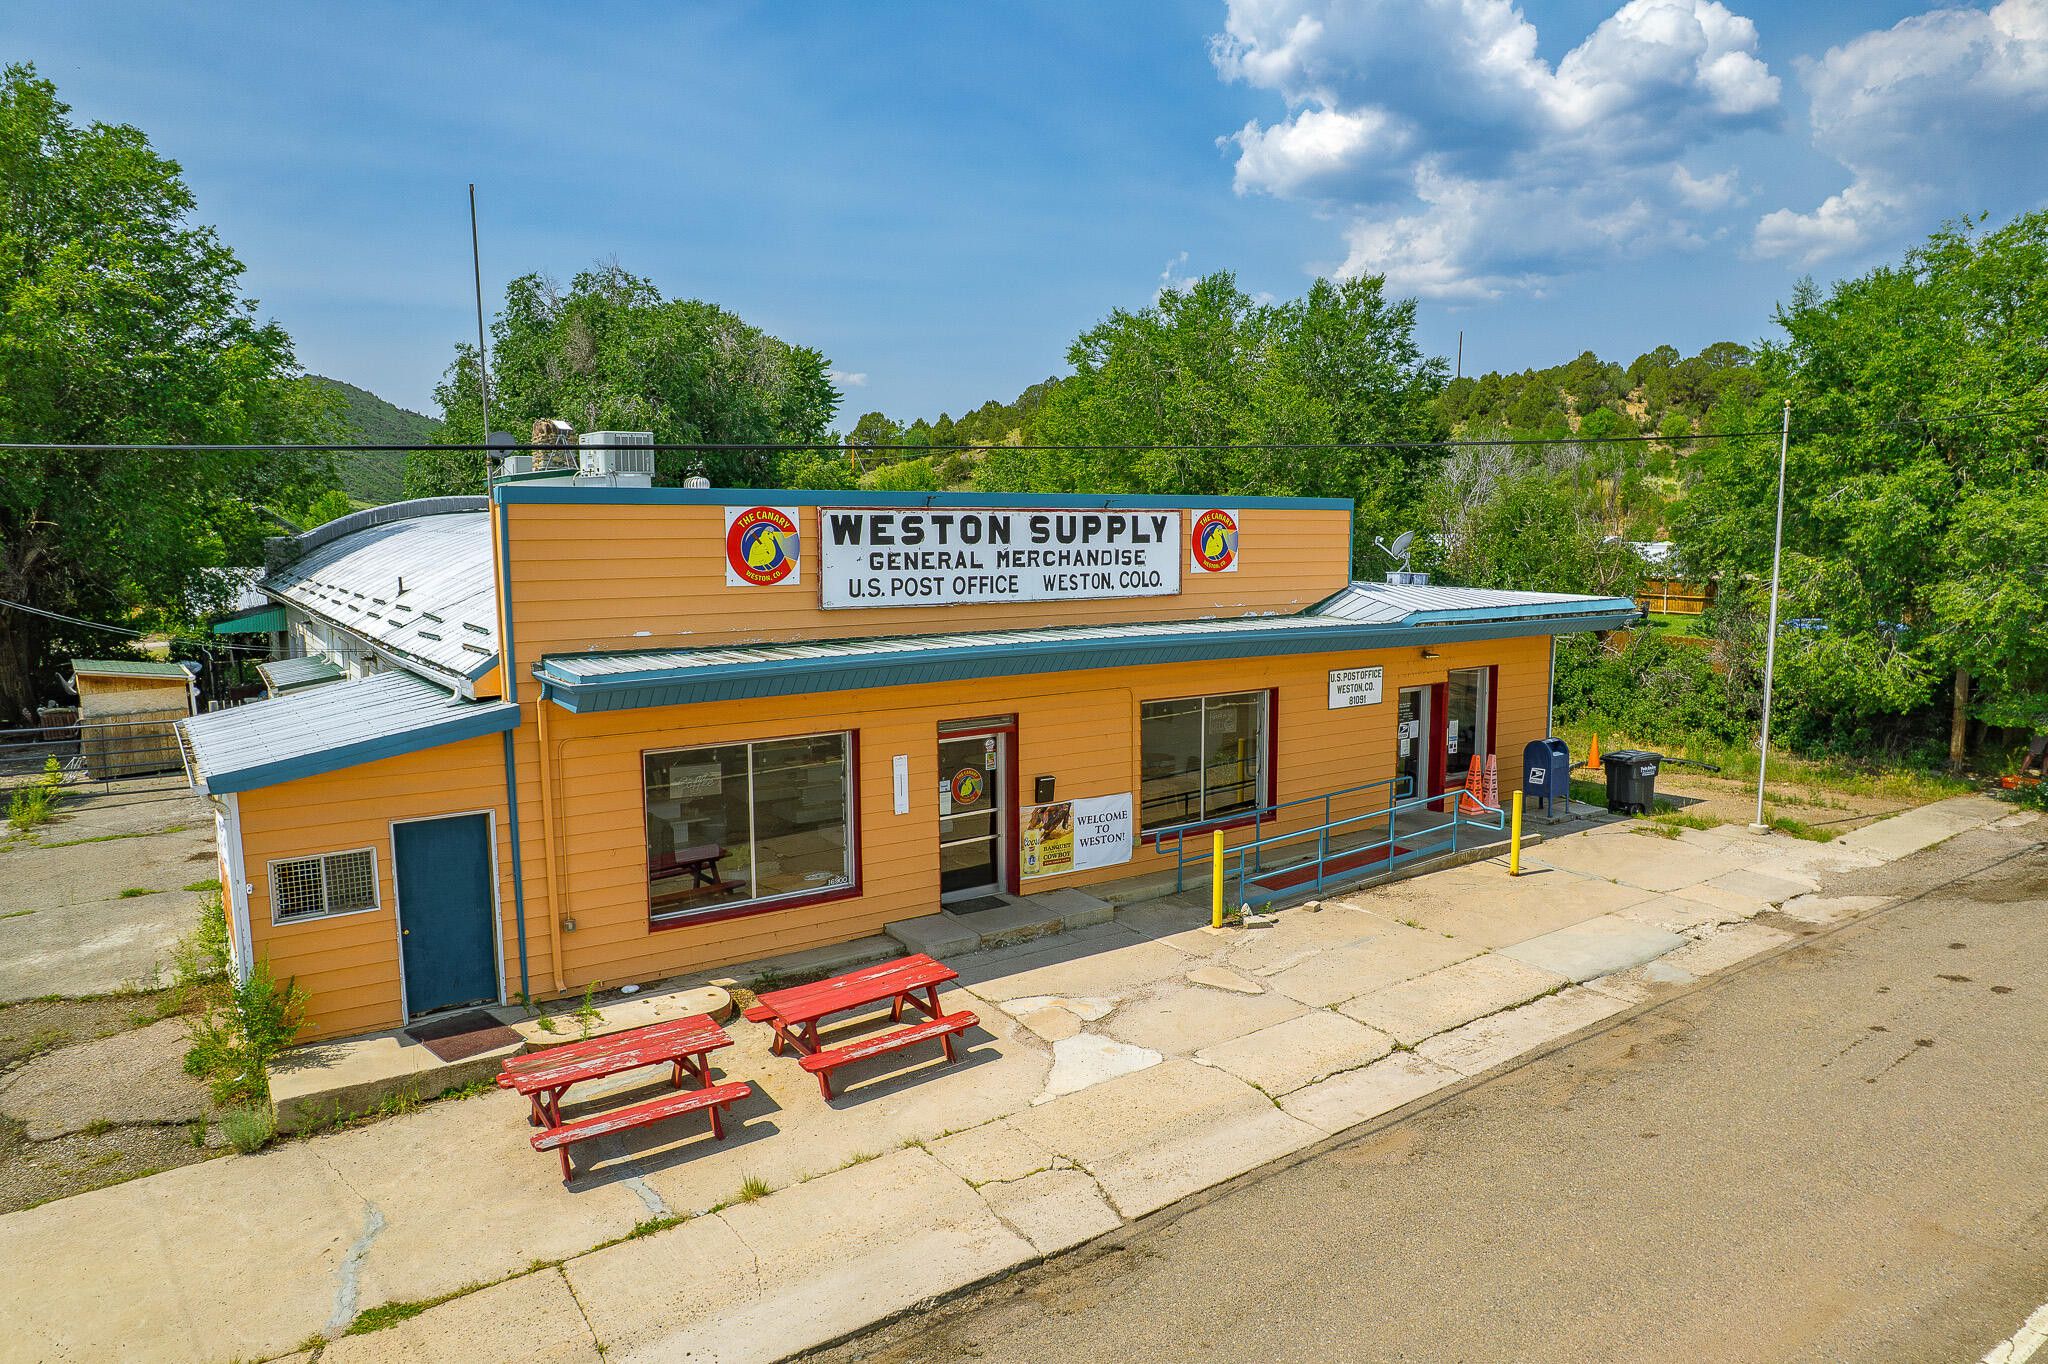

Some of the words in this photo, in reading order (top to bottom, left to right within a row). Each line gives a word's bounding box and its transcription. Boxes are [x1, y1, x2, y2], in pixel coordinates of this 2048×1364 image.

[737, 513, 756, 528] THE
[756, 511, 791, 529] CANARY
[1199, 515, 1211, 527] THE
[1211, 512, 1234, 527] CANARY
[830, 515, 1011, 546] WESTON
[1029, 515, 1168, 545] SUPPLY
[869, 550, 984, 571] GENERAL
[996, 549, 1146, 569] MERCHANDISE
[849, 577, 885, 598] U.S.
[891, 576, 945, 597] POST
[952, 575, 1019, 595] OFFICE
[1043, 572, 1115, 591] WESTON,
[1119, 570, 1163, 588] COLO.
[1348, 695, 1367, 705] 81091
[1077, 810, 1128, 826] WELCOME
[1095, 824, 1110, 834] TO
[1079, 832, 1125, 848] WESTON!
